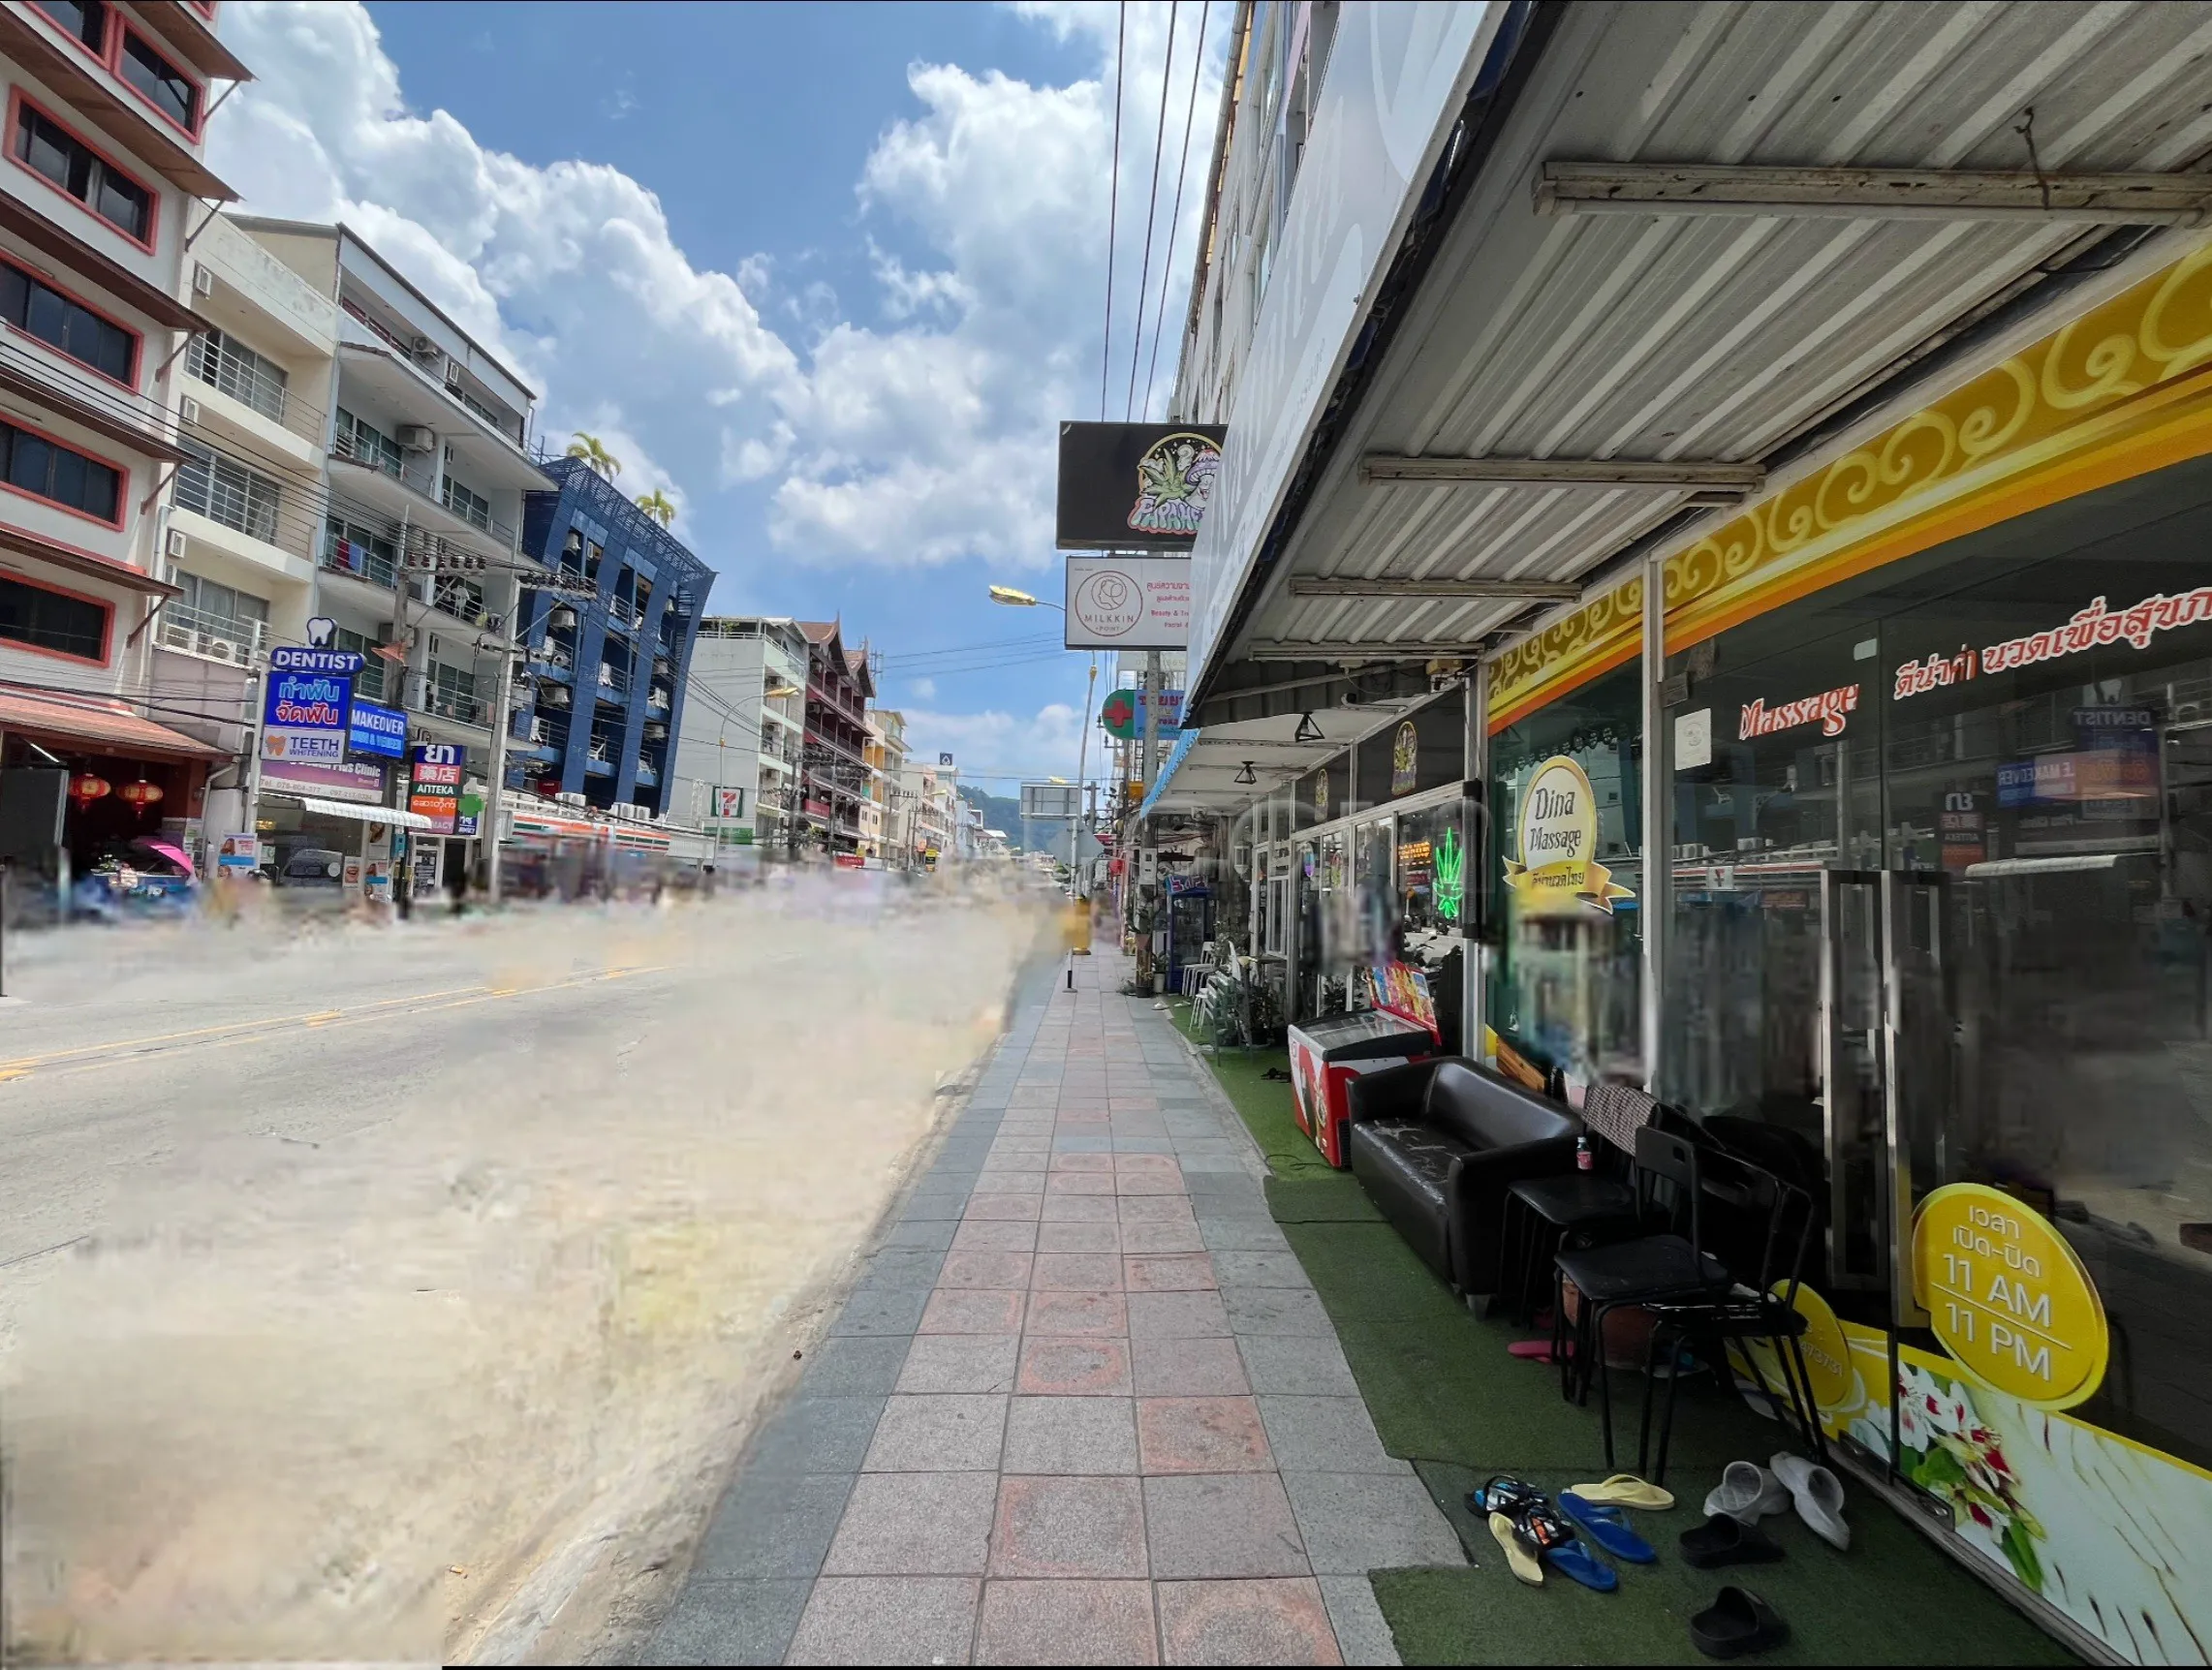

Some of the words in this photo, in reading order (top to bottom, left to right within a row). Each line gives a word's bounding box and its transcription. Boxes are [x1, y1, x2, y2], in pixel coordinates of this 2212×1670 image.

[1084, 614, 1134, 623] MILKKIN
[275, 650, 358, 670] DENTIST
[279, 676, 339, 701] ทำฟัน
[275, 699, 339, 725] จัดฟัน
[351, 709, 404, 735] MAKEOVER
[1739, 683, 1859, 740] Massage
[290, 749, 339, 758] WHITENING
[291, 736, 340, 750] TEETH
[424, 744, 454, 764] ยา
[355, 762, 381, 777] Clinic
[417, 784, 454, 794] АПТЕКА
[1535, 788, 1575, 820] Dina
[1530, 826, 1582, 857] Massage
[1969, 1204, 2020, 1239] เวลา
[1953, 1224, 2041, 1278] เปิด-ปิด
[1943, 1253, 1972, 1292] 11
[1988, 1275, 2051, 1328] AM
[1946, 1303, 1975, 1343] 11
[1991, 1323, 2051, 1381] PM
